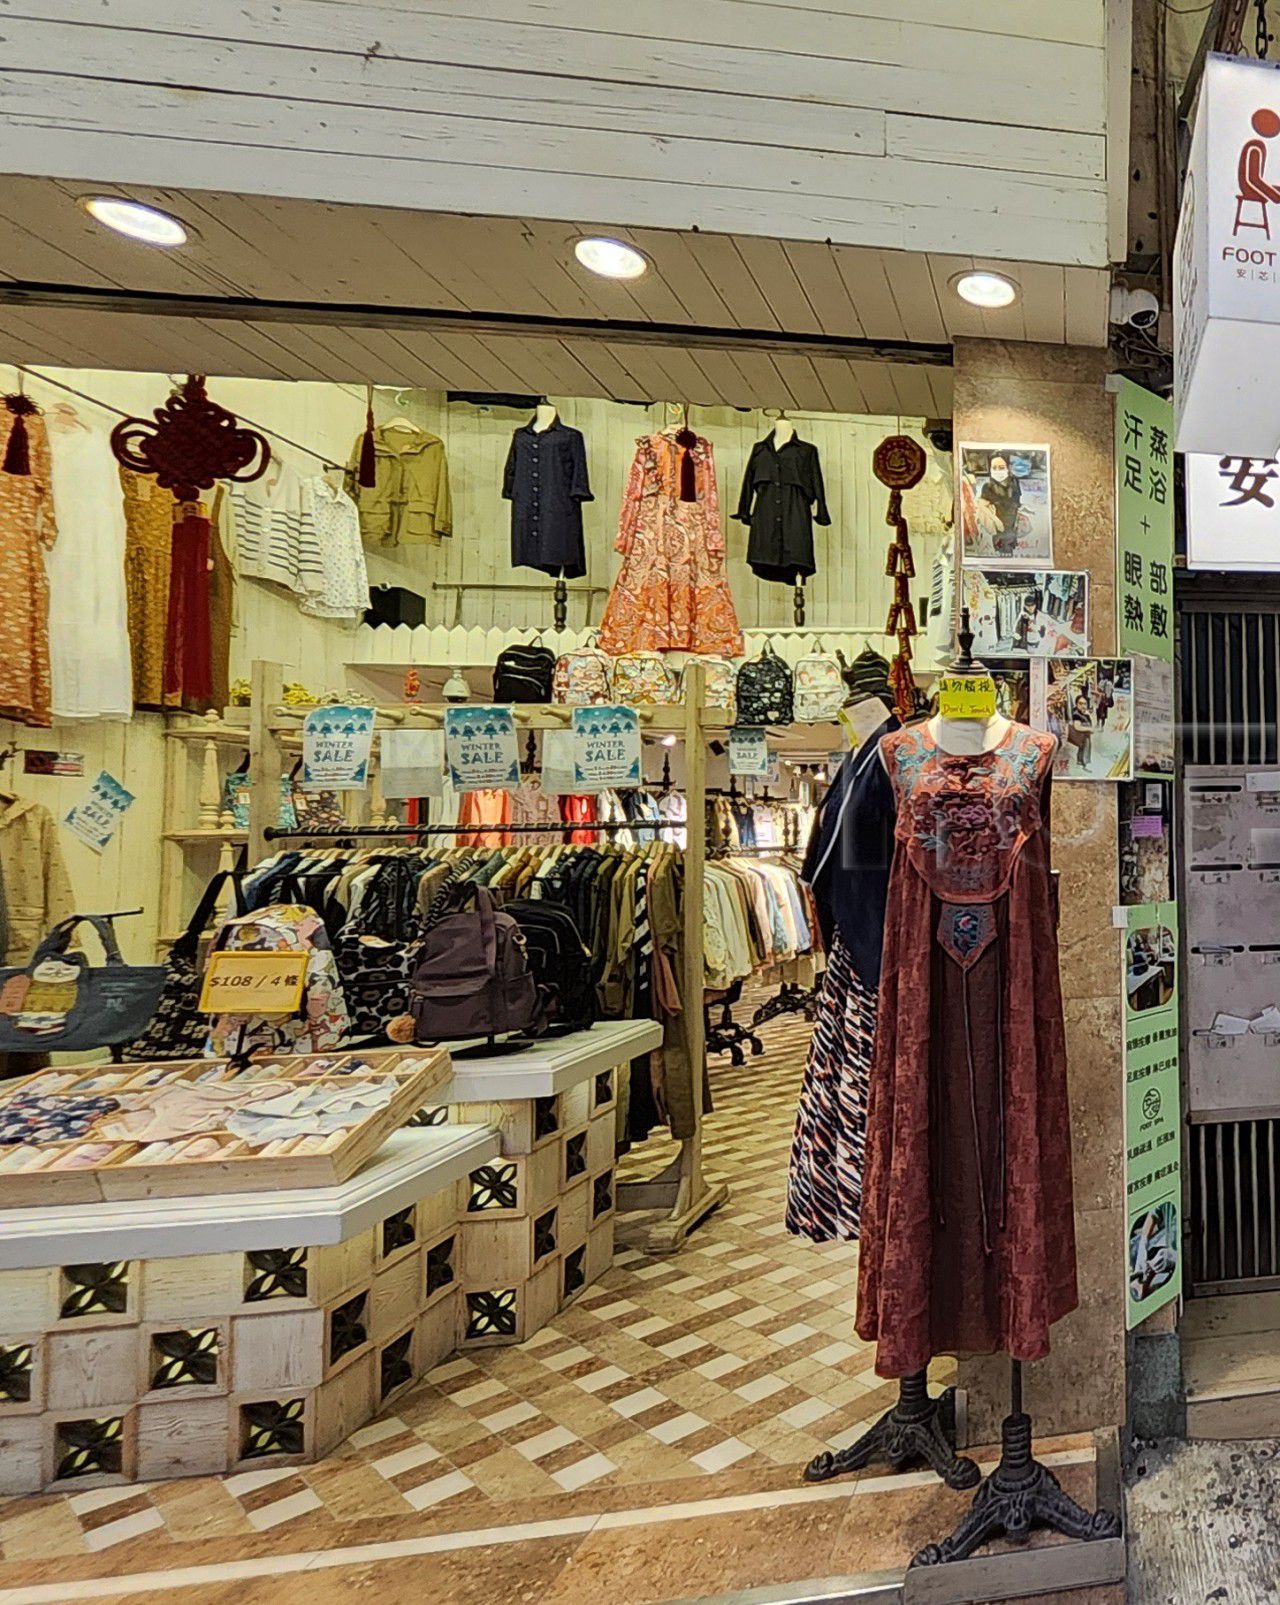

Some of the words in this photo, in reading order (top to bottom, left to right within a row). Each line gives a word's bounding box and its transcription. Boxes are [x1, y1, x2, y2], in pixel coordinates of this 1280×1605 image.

[1222, 246, 1276, 267] FOOT
[316, 741, 354, 749] WINTER
[461, 742, 501, 751] WINTER
[586, 740, 625, 749] WINTER
[313, 750, 354, 763] SALE
[460, 752, 504, 765] SALE
[585, 749, 626, 763] SALE
[209, 975, 253, 987] $108
